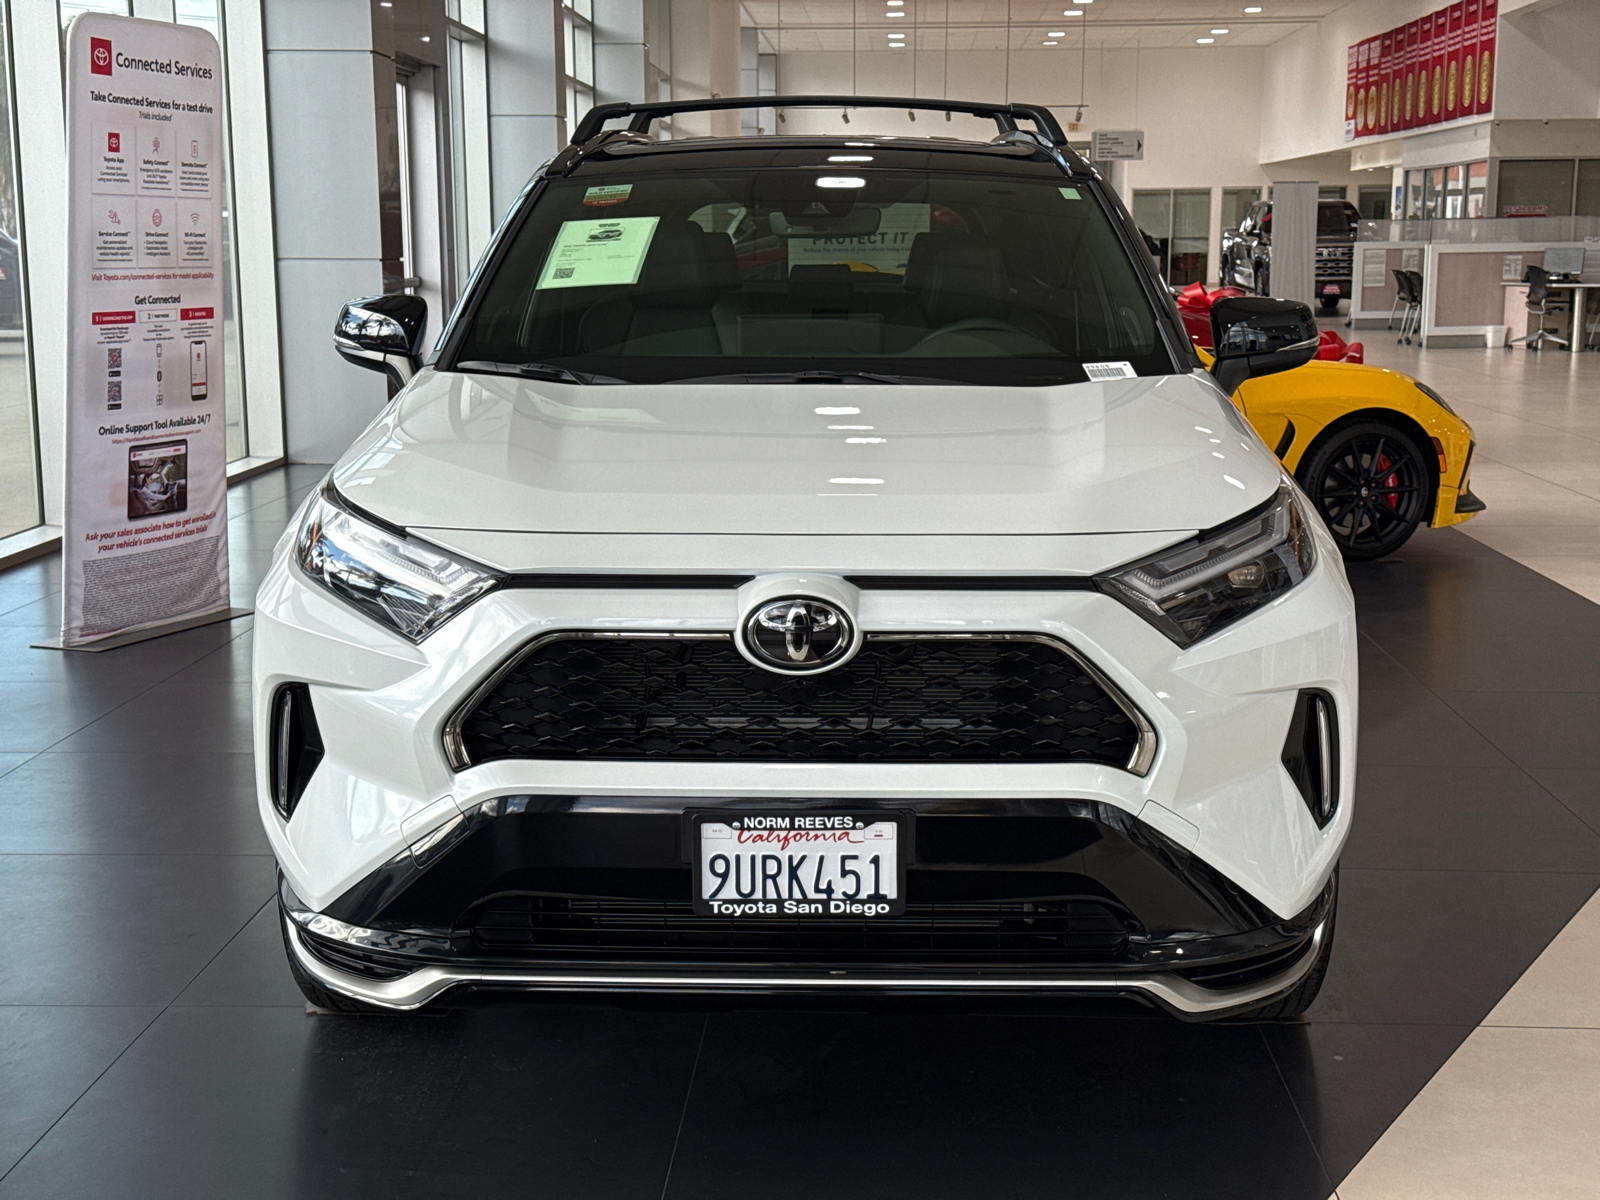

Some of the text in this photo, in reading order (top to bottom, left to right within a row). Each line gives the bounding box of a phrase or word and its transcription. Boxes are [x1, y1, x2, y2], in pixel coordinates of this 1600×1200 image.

[116, 52, 213, 79] Connected Services
[90, 91, 213, 114] Take Connected Services for a test drive
[139, 111, 150, 120] Trials
[893, 232, 909, 245] IT
[103, 272, 172, 282] Toyota.com/connected-services
[179, 271, 191, 279] model
[191, 271, 213, 280] applicability
[134, 293, 181, 305] Get Connected
[98, 413, 211, 436] Online Support Tool Available 24/7
[86, 532, 98, 542] Ask
[99, 530, 116, 542] your
[116, 527, 133, 538] sales
[134, 523, 161, 535] associate
[162, 521, 174, 530] how
[175, 518, 182, 527] to
[182, 516, 192, 528] get
[192, 512, 212, 524] enrolled
[98, 543, 114, 554] your
[115, 537, 142, 550] vehicle's
[143, 532, 174, 545] connected
[174, 528, 195, 539] services
[744, 816, 853, 829] NORM REEVES
[737, 829, 865, 851] California
[709, 853, 888, 899] 9URK451
[709, 900, 890, 916] Toyota San Diego
